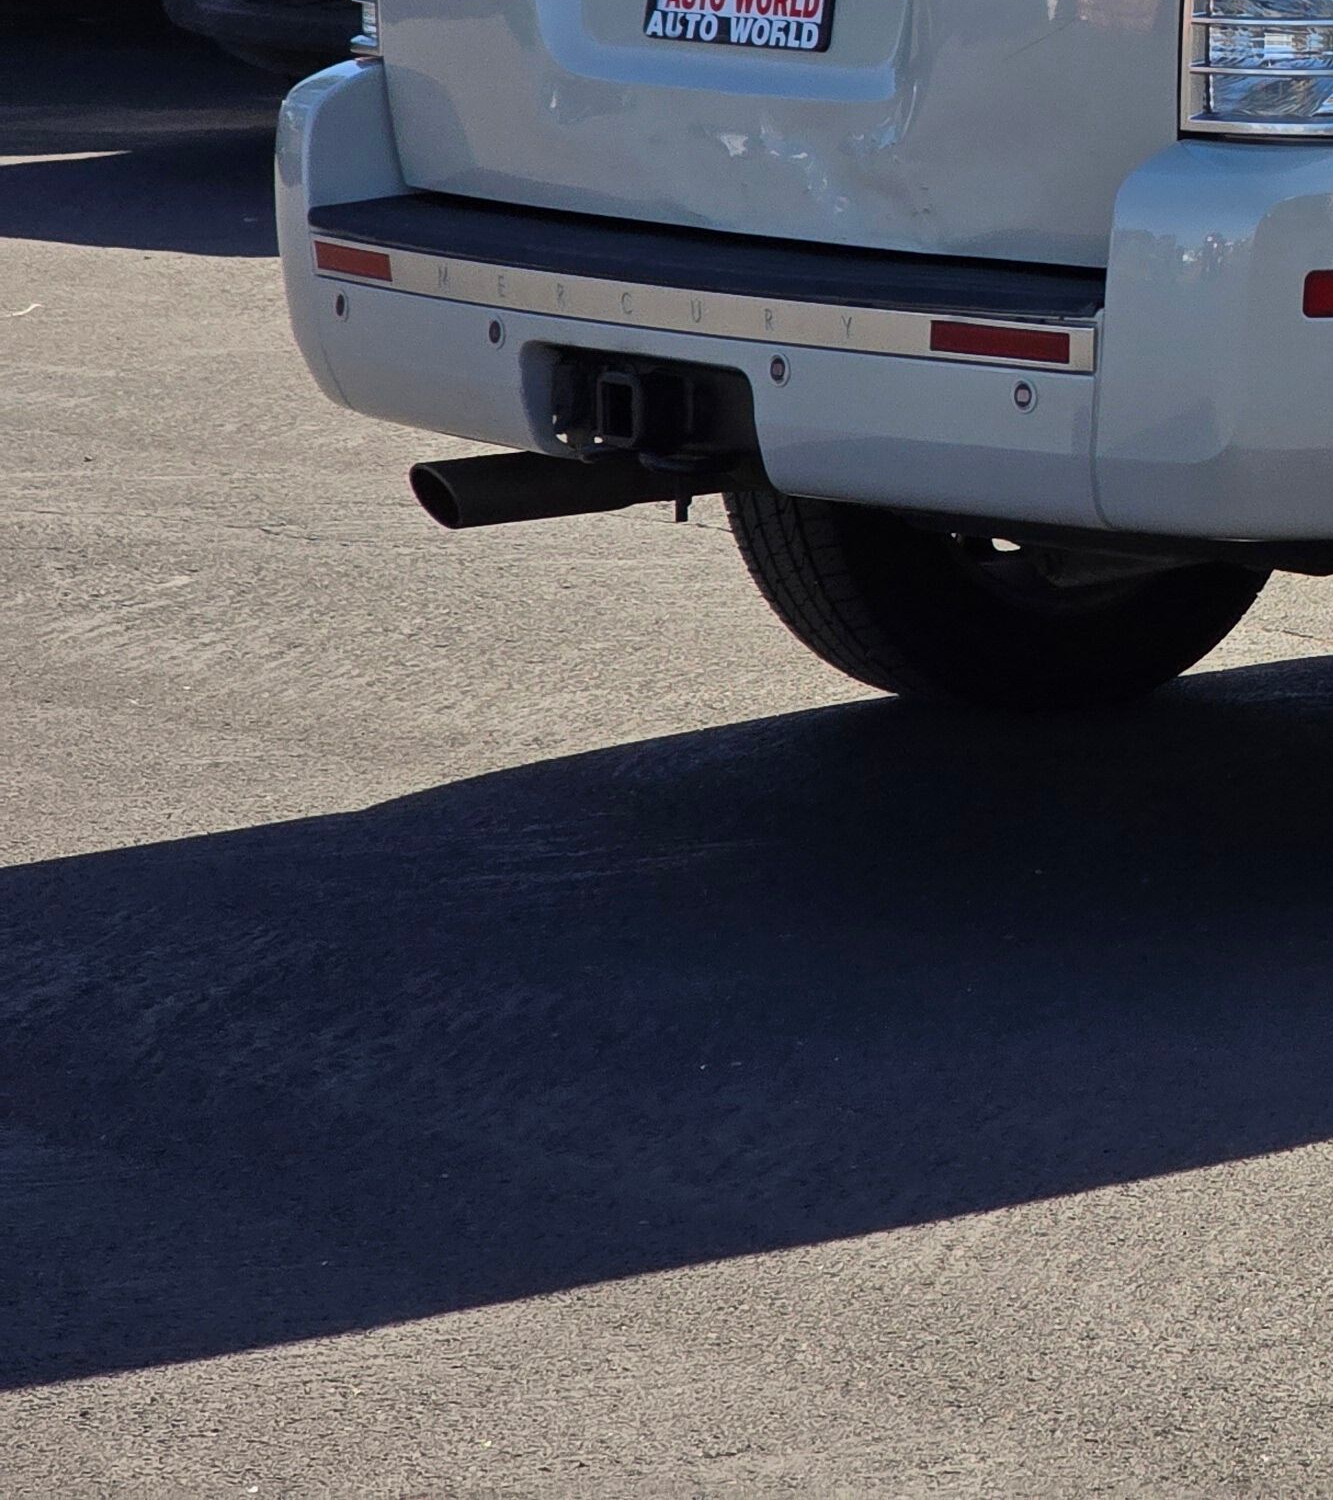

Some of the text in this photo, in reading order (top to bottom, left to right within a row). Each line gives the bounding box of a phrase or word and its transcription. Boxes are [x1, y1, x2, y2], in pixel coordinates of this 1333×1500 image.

[646, 10, 819, 49] AUTO WORLD
[438, 266, 853, 339] MERCURY
